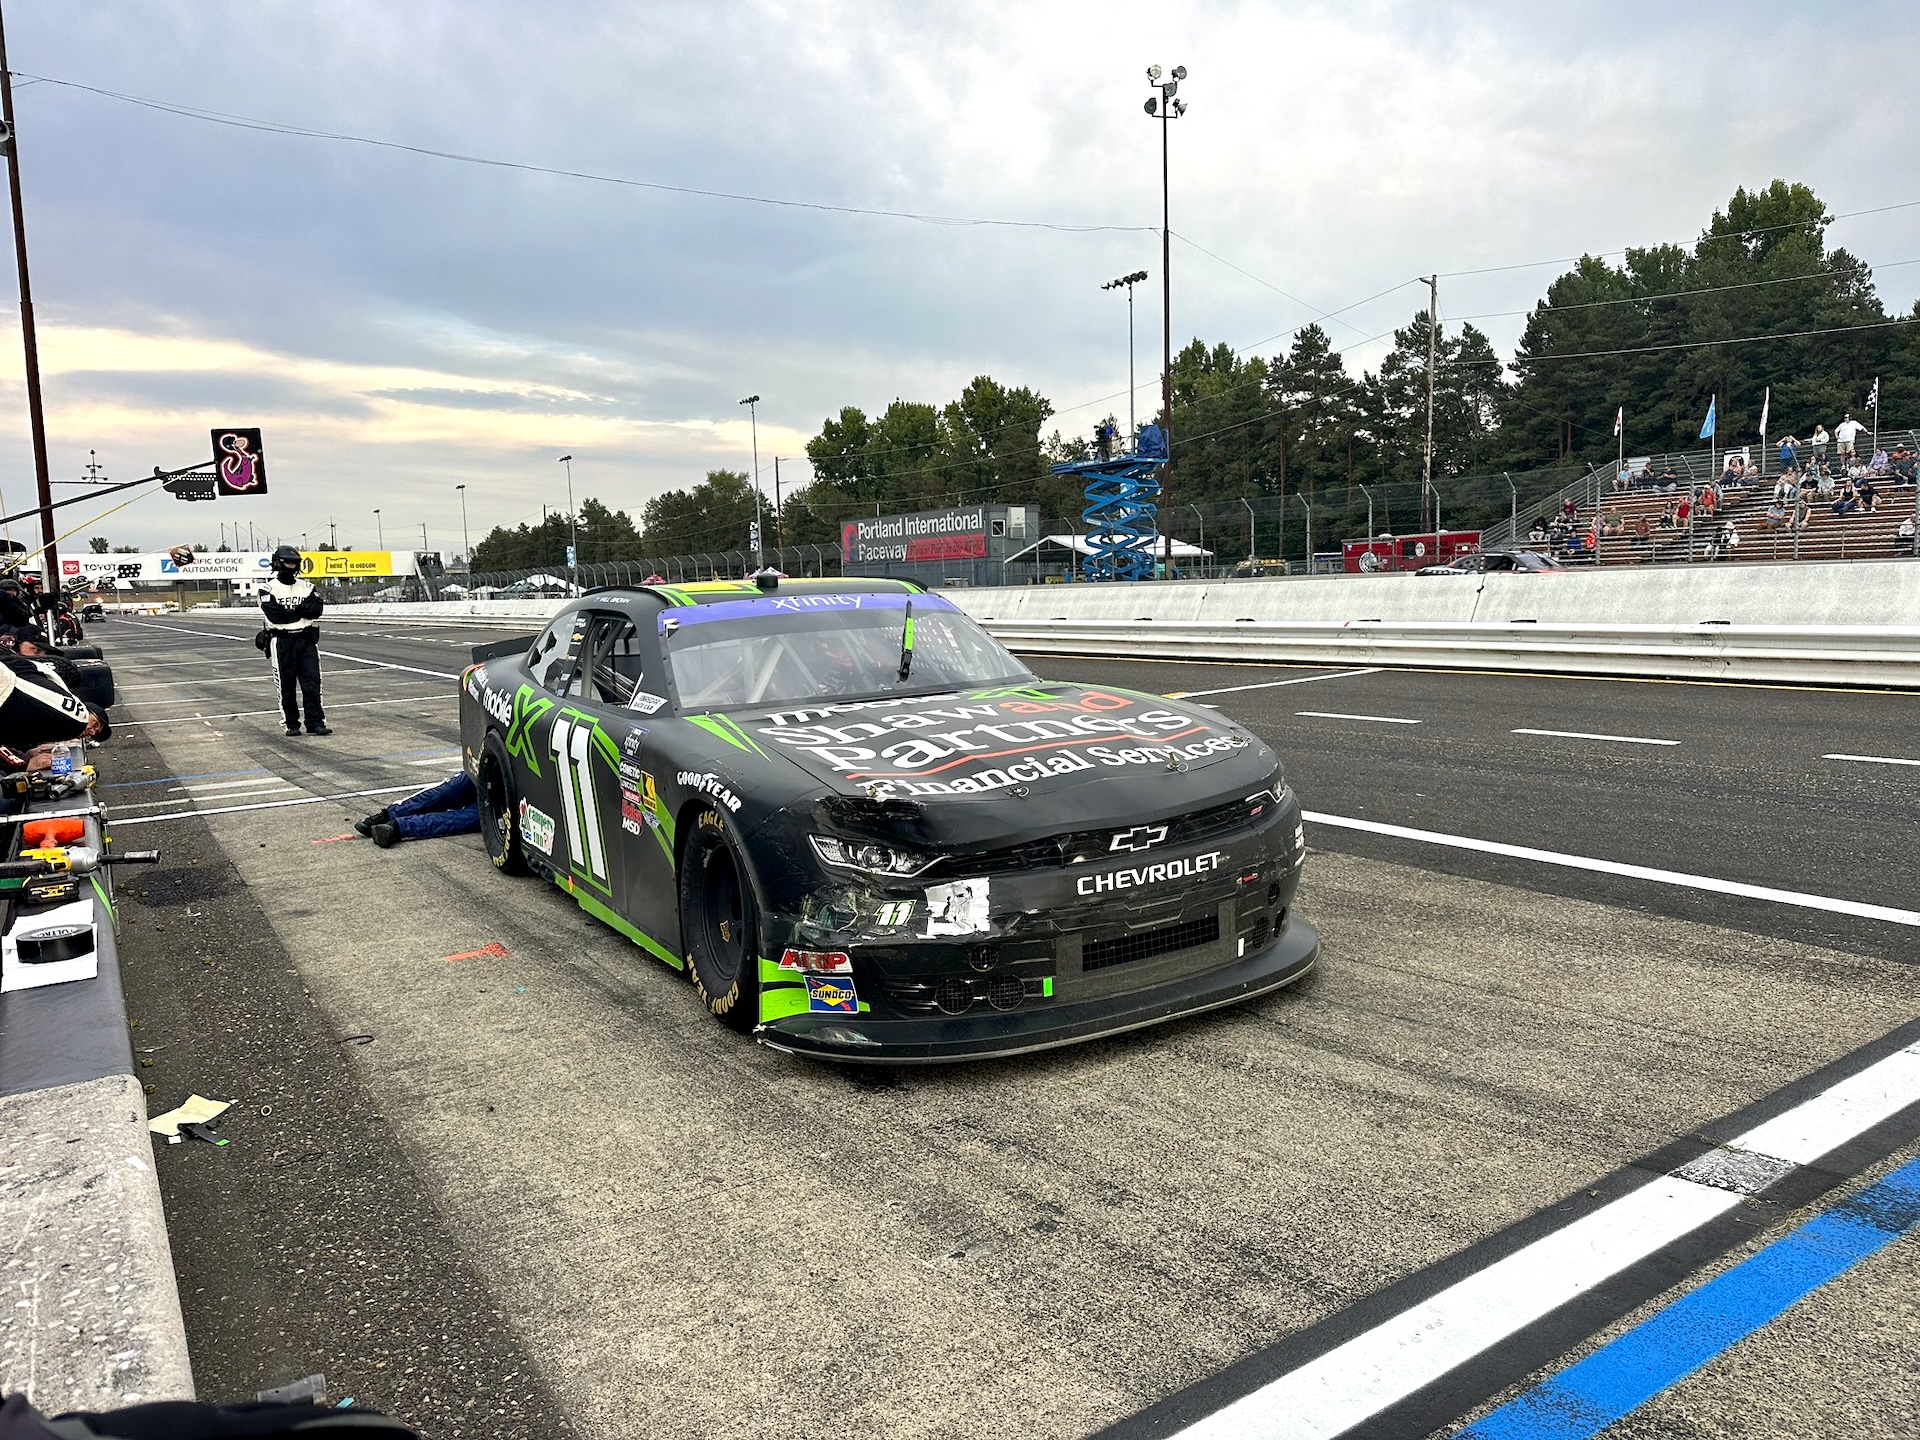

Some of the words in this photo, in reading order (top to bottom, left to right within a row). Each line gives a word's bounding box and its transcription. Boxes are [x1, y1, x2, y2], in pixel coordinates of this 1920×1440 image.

[857, 518, 902, 540] Portland
[905, 508, 982, 536] International
[214, 557, 244, 565] OFFICE
[858, 543, 908, 562] Raceway
[83, 563, 118, 571] TOYOT
[182, 565, 238, 573] AUTOMATION
[772, 594, 861, 612] xfinity
[482, 688, 512, 728] mobile
[1000, 691, 1135, 714] and
[855, 748, 1096, 800] Financial
[1086, 735, 1250, 766] Services
[551, 713, 608, 883] 11
[677, 770, 742, 813] GOODYEAR
[622, 817, 641, 836] MSD
[697, 810, 725, 833] EAGLE
[1076, 851, 1221, 896] CHEVROLET
[876, 899, 914, 926] 11
[812, 989, 852, 1000] SUNOCO
